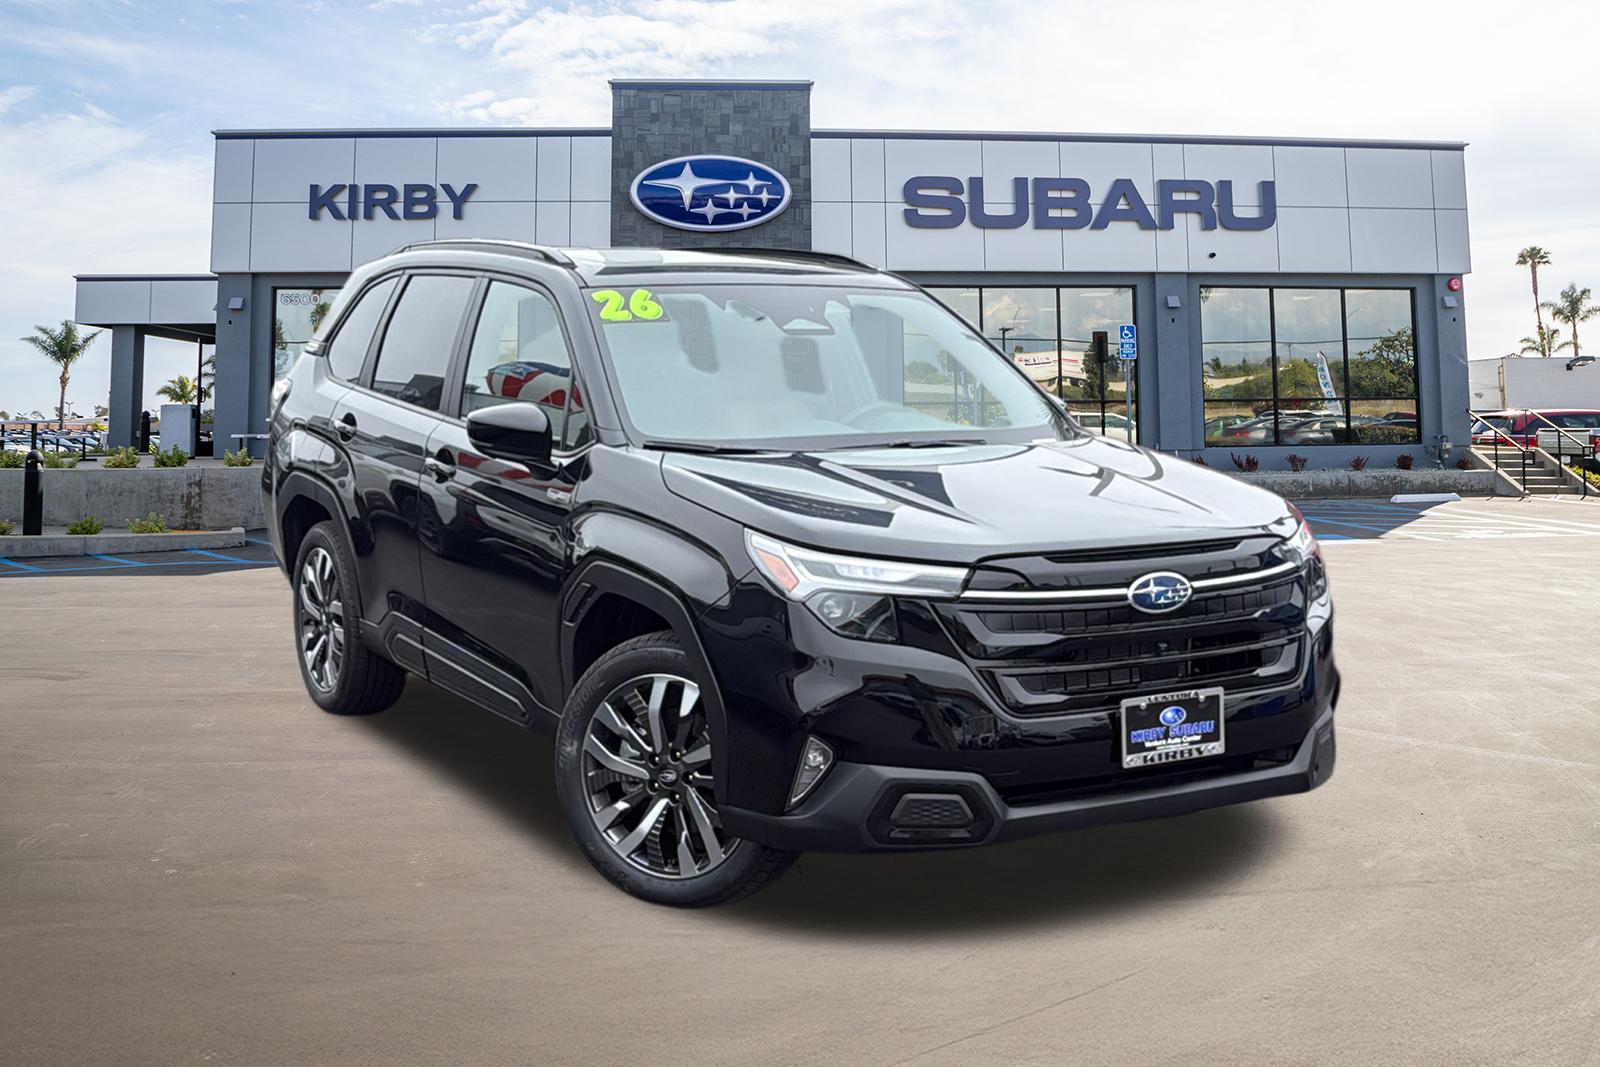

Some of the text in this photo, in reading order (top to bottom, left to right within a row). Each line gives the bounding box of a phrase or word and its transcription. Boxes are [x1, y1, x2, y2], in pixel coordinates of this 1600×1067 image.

[308, 183, 479, 220] KIRBY
[902, 176, 1277, 231] SUBARU
[591, 287, 664, 321] 26
[1130, 720, 1215, 744] KIRBY SUBARU
[1143, 746, 1206, 764] KIRBY
